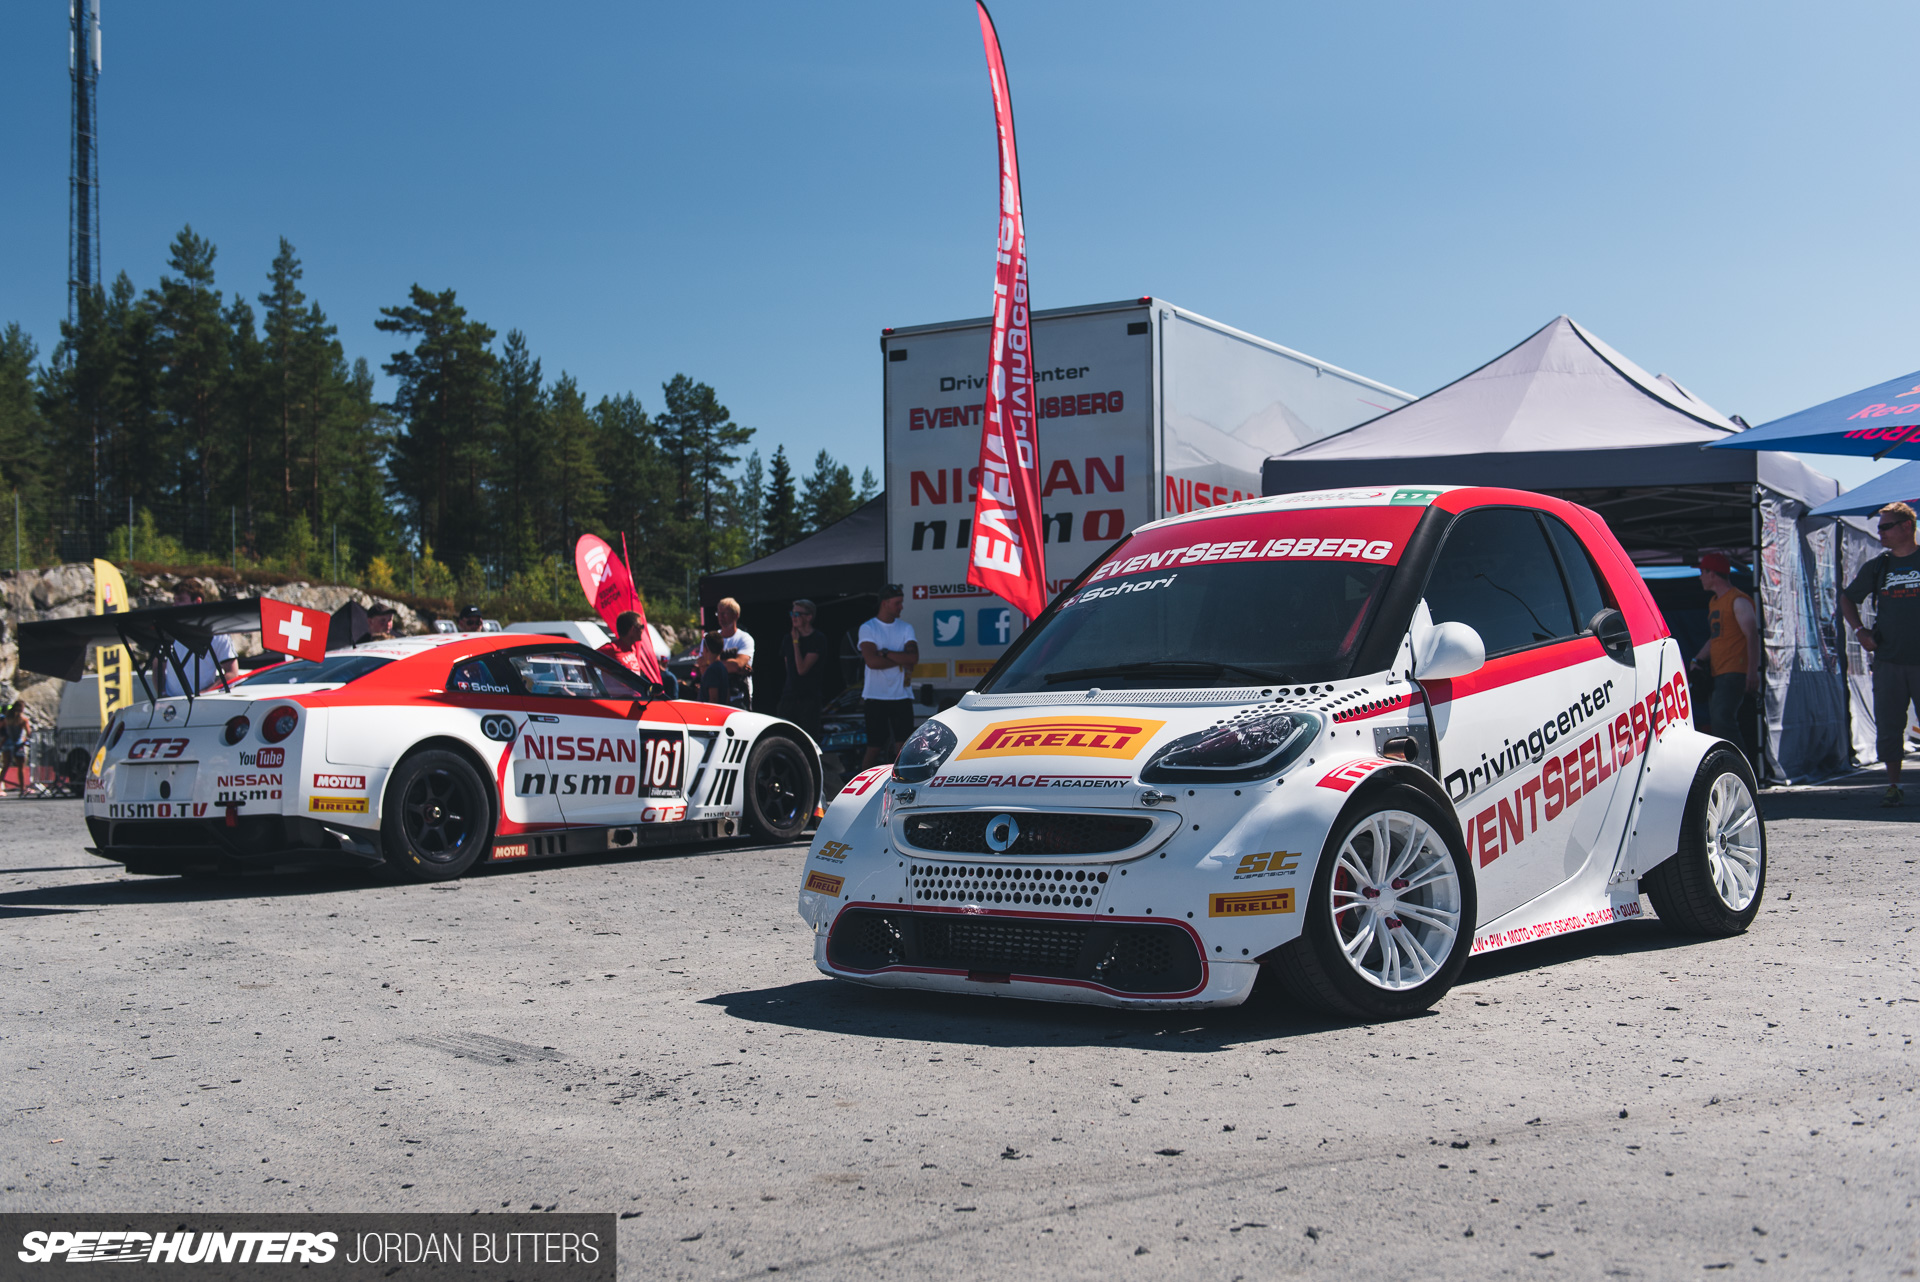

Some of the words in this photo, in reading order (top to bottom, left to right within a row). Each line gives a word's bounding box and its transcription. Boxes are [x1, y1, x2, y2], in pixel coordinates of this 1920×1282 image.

[940, 366, 1090, 392] Drivienter
[909, 391, 1124, 431] EVENTISBERG
[910, 455, 1125, 507] NIAN
[1087, 538, 1393, 583] EVENTSEELISBERG
[1079, 574, 1178, 604] Schori
[471, 682, 510, 693] Schori
[976, 723, 1143, 750] PIRELLI
[1444, 679, 1614, 804] Drivingcenter
[128, 738, 190, 759] GT3
[239, 748, 285, 767] YouTube
[524, 735, 636, 763] NISSAN
[643, 739, 683, 788] 161
[1466, 671, 1690, 869] VENTSEELISBERG
[217, 774, 283, 787] NISSAN
[316, 776, 363, 788] MOTUL
[521, 773, 635, 795] nismo
[1050, 780, 1130, 788] ACADEMY
[313, 798, 366, 811] PIRELLI
[641, 805, 687, 822] GT3
[495, 845, 527, 858] MOTUL
[808, 874, 841, 893] PIRELLI
[1215, 893, 1289, 913] PIRELLI
[1489, 932, 1503, 948] PW
[1507, 927, 1531, 944] MOTO
[1532, 915, 1585, 938] DRIFT-SCHOOL
[1586, 907, 1617, 925] GO-KART
[1619, 901, 1641, 917] QUAD
